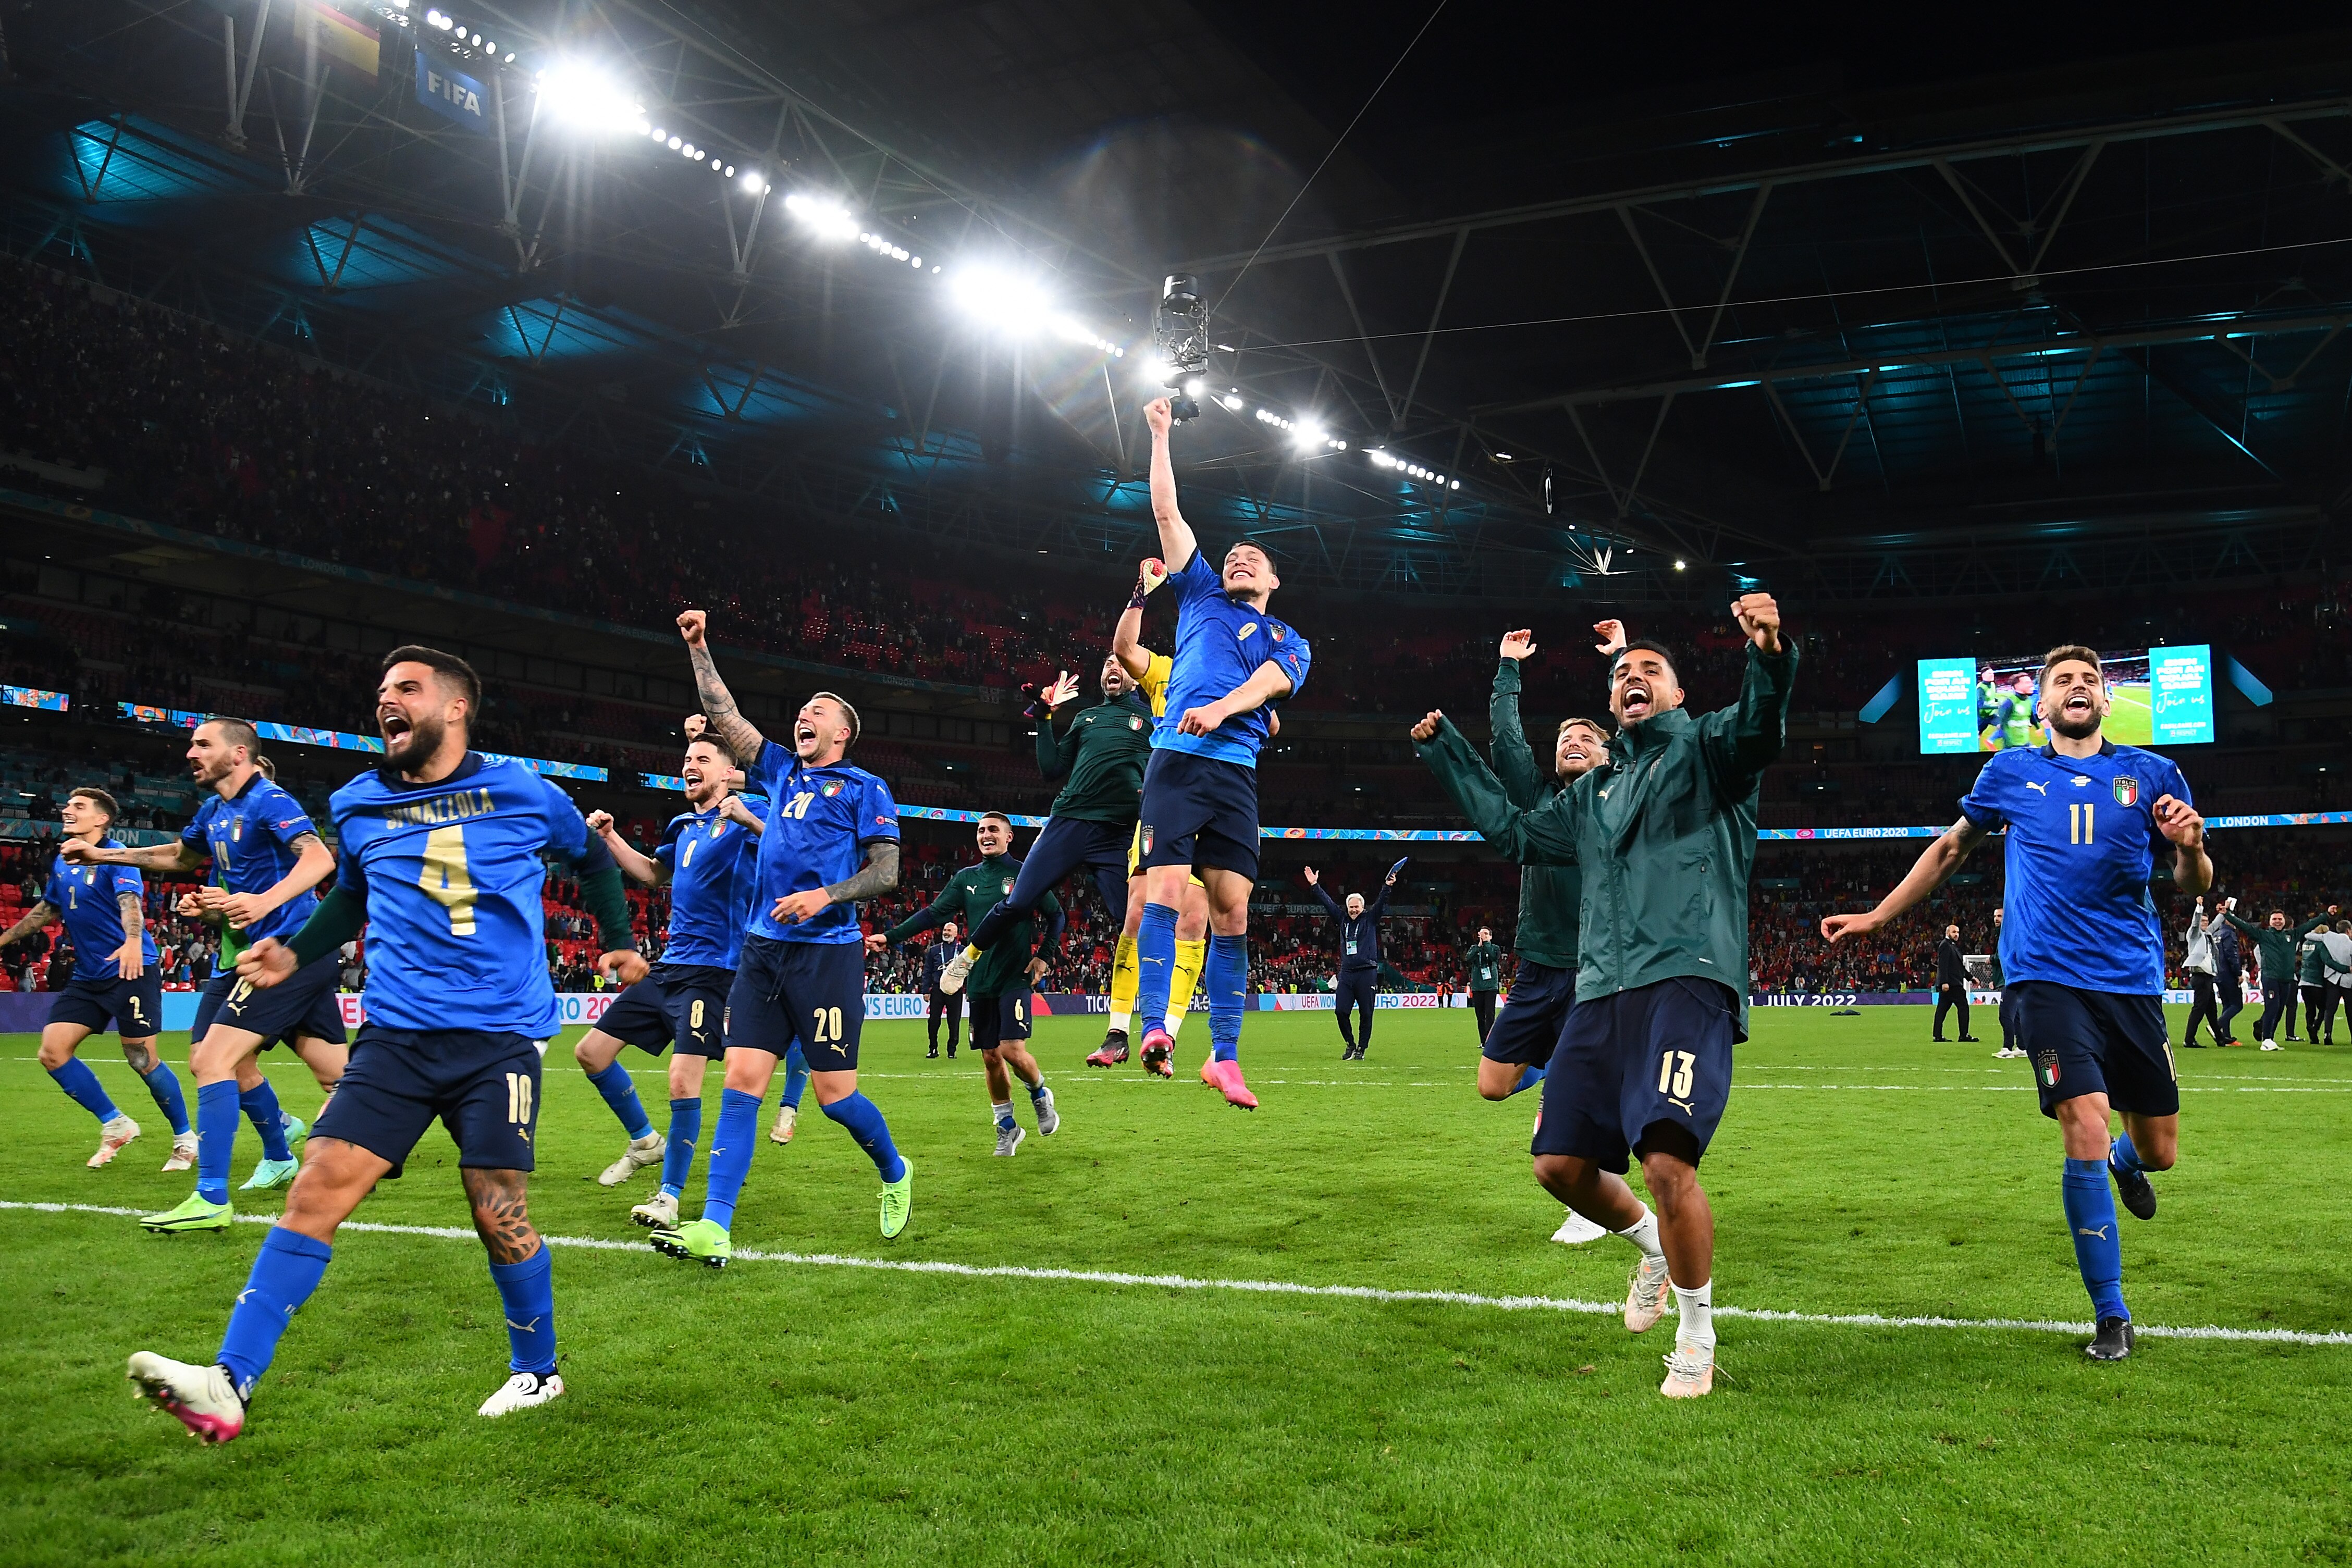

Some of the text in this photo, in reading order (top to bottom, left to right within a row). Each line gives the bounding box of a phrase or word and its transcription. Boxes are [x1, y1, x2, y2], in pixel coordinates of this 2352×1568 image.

[427, 70, 482, 116] FIFA
[1237, 622, 1258, 641] 9
[2156, 665, 2205, 675] FOR AN
[2158, 673, 2203, 683] EQUAL
[1925, 678, 1950, 686] FOR
[1926, 685, 1969, 694] EQUAL
[1924, 702, 1971, 723] Join us
[2156, 692, 2205, 713] Join us
[781, 791, 816, 820] 20
[2069, 803, 2094, 845] 11
[2219, 816, 2269, 827] LONDON
[1824, 828, 1908, 838] UEFA EURO 2020
[418, 824, 479, 936] 4
[226, 976, 254, 1003] 19
[1763, 995, 1806, 1006] JULY
[1811, 994, 1857, 1006] 2022
[129, 996, 144, 1020] 2
[884, 997, 922, 1015] EURO
[1015, 998, 1024, 1021] 6
[1301, 996, 1319, 1008] UEFA
[1402, 995, 1436, 1007] 2022
[690, 999, 705, 1029] 8
[813, 1006, 843, 1043] 20
[2039, 1056, 2055, 1066] ITALIA
[1658, 1050, 1696, 1099] 13
[506, 1071, 533, 1126] 10
